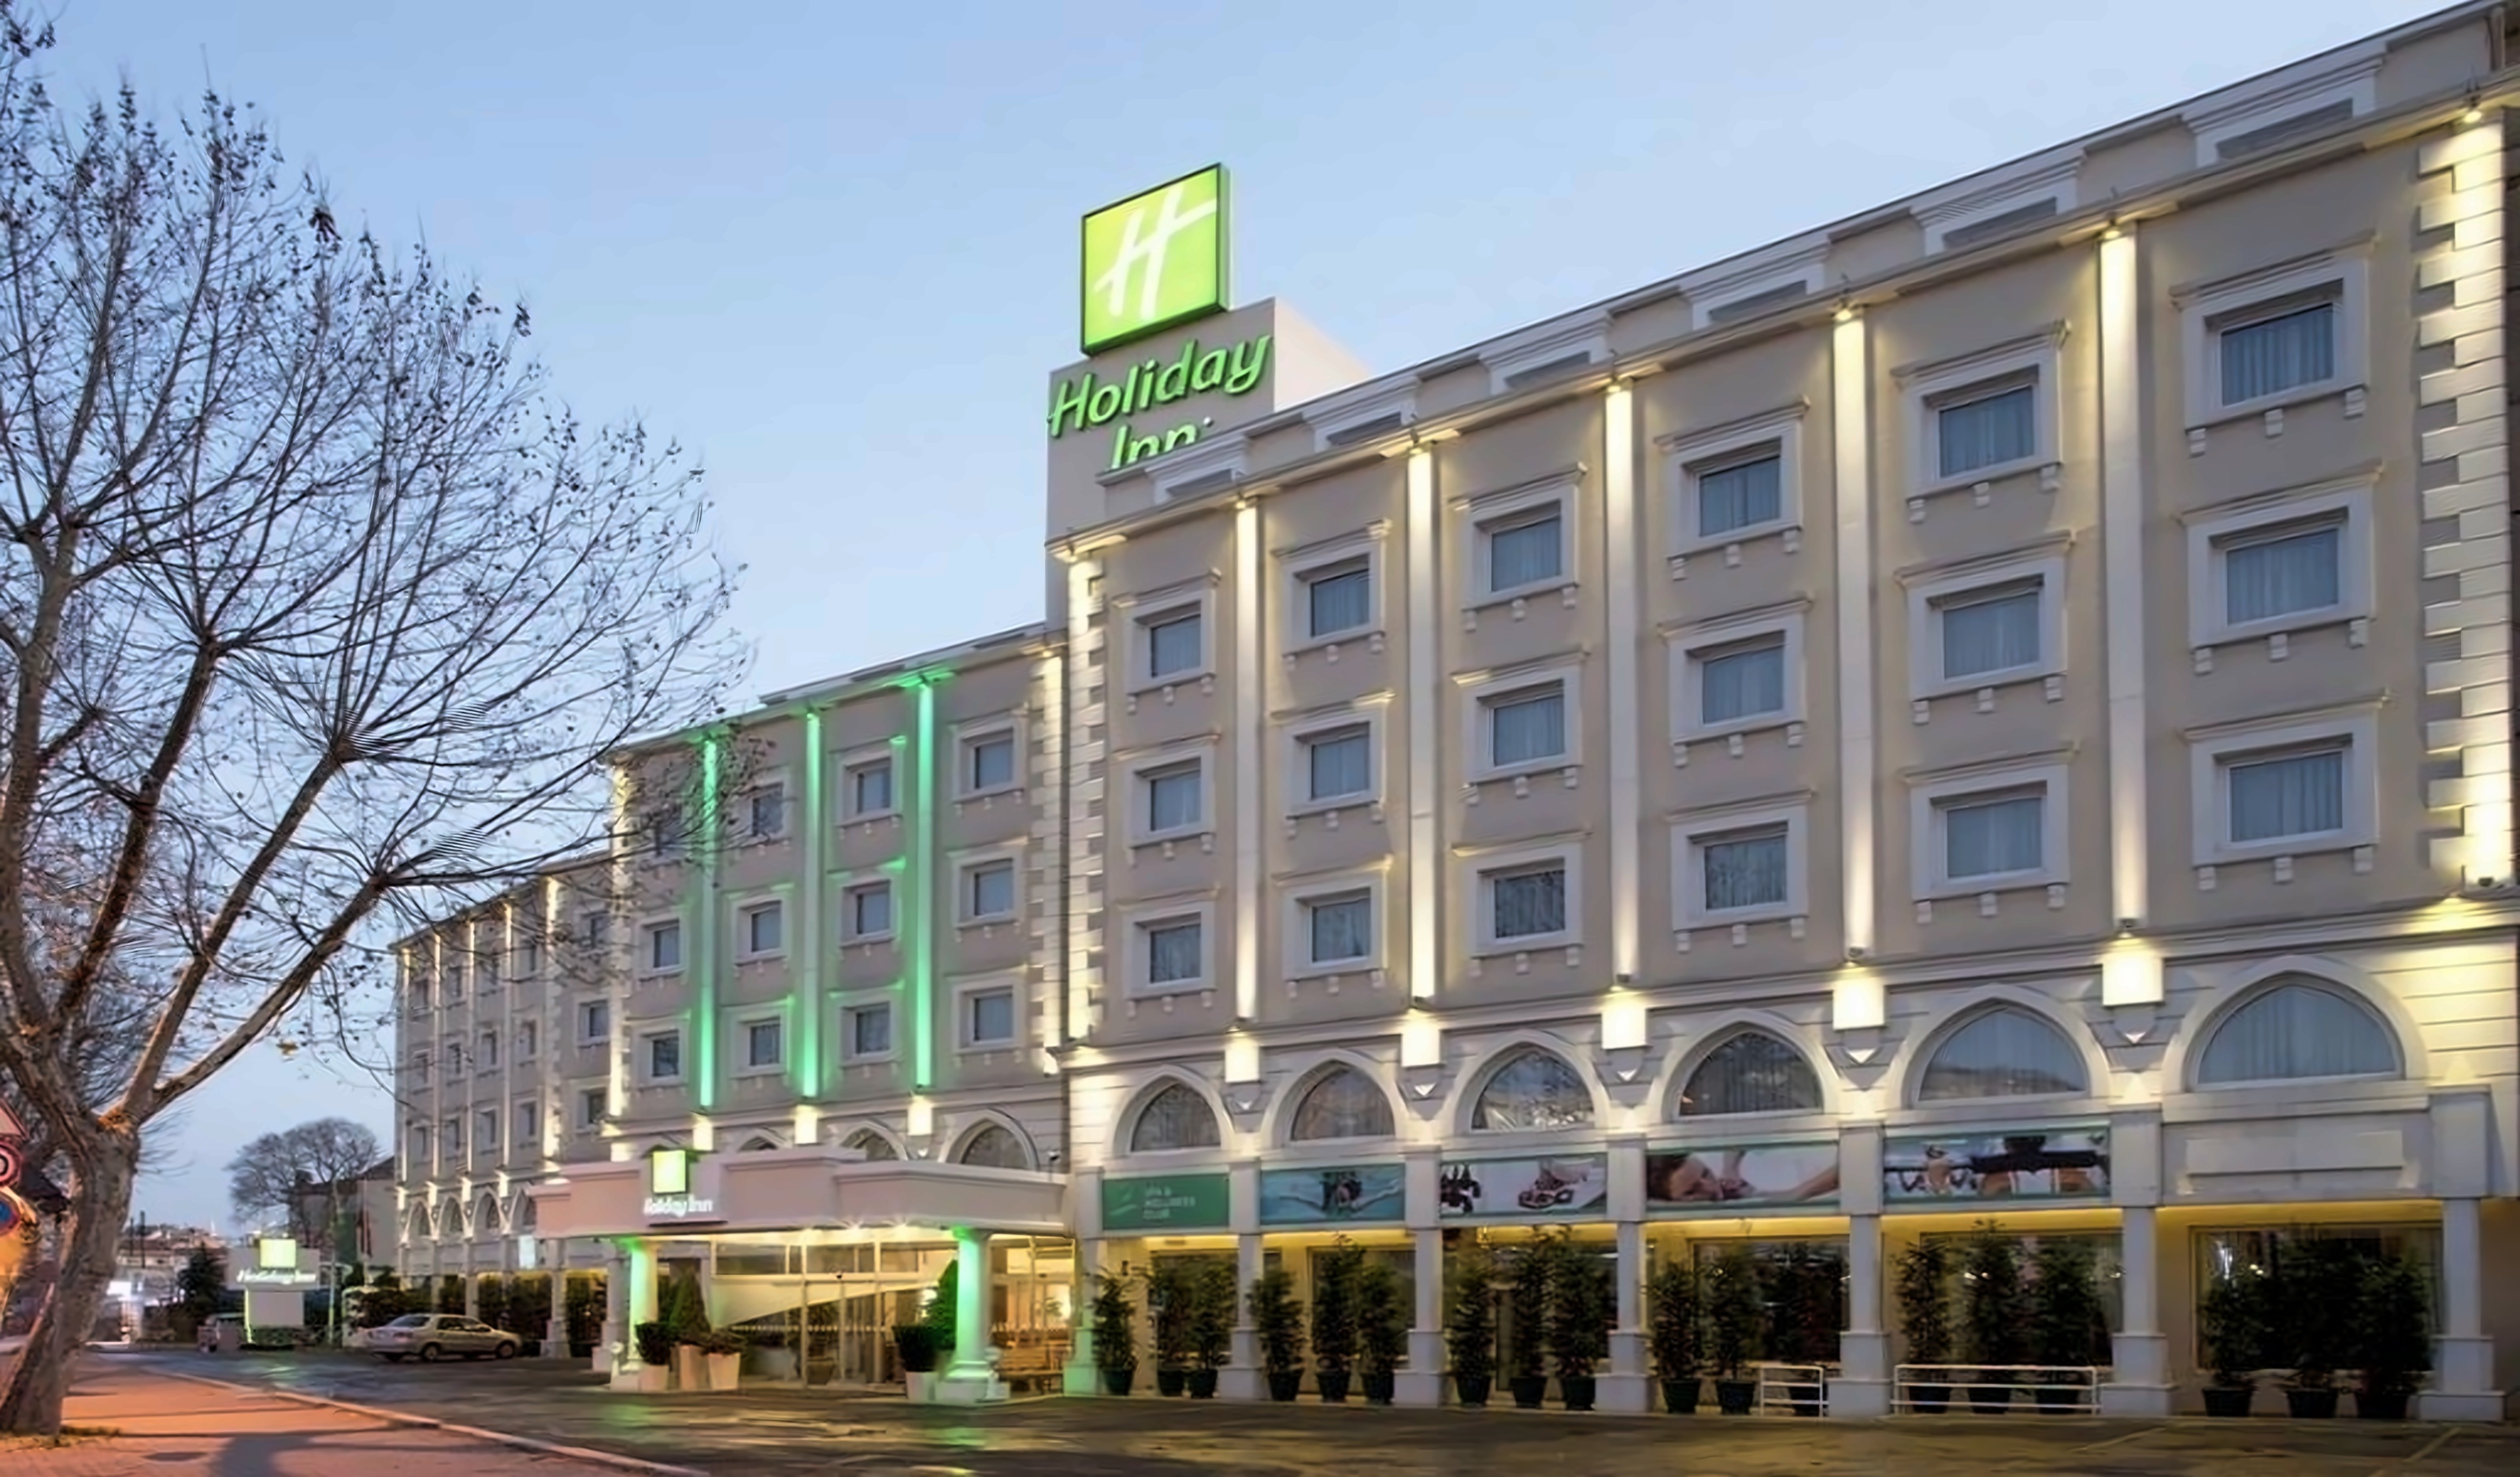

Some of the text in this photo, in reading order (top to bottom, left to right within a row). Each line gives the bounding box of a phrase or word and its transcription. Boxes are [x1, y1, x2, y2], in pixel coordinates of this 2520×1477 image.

[1047, 335, 1273, 438] Holiday
[1111, 425, 1197, 469] Inn
[688, 1194, 713, 1212] Inn
